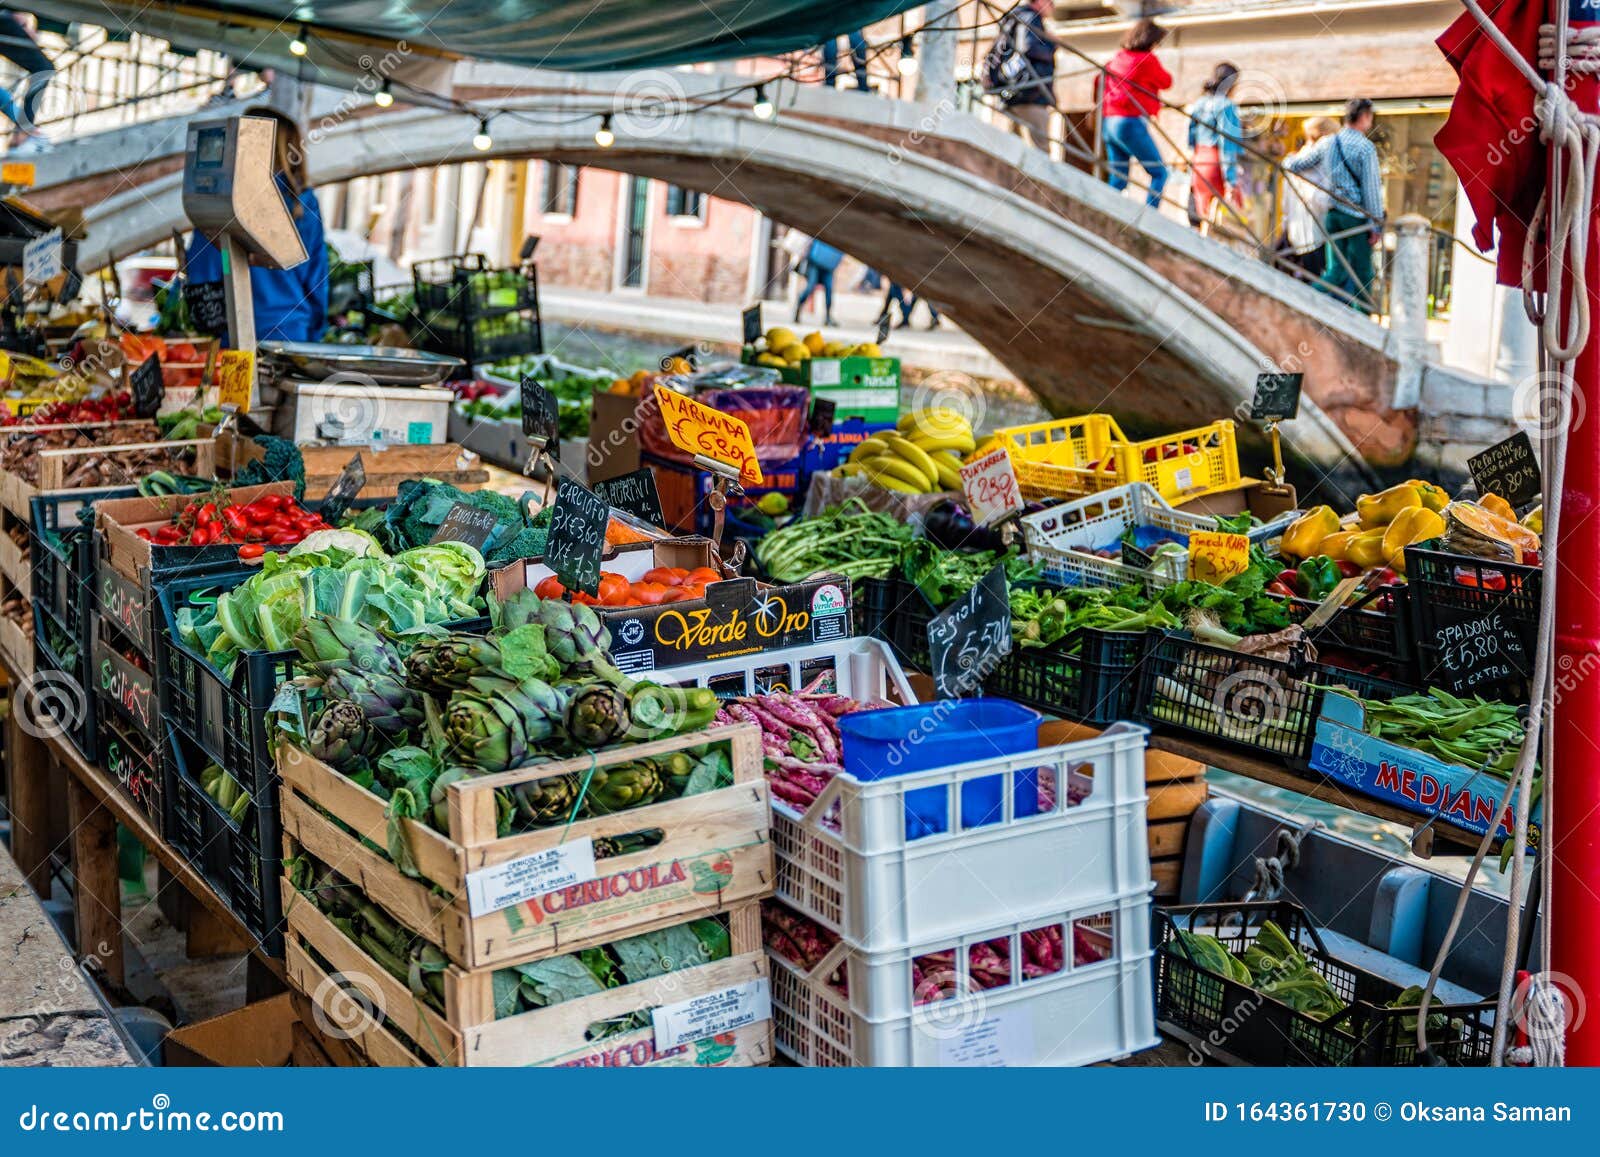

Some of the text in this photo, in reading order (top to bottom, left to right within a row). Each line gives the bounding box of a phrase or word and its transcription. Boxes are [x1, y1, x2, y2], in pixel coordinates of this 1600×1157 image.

[658, 388, 746, 441] MARINDA
[559, 482, 605, 521] CARCIOFO
[655, 608, 747, 650] Verde
[755, 596, 809, 638] Oro
[1436, 615, 1504, 650] SPADONE
[1375, 761, 1517, 836] MEDIANA
[542, 858, 686, 914] CERICOLA
